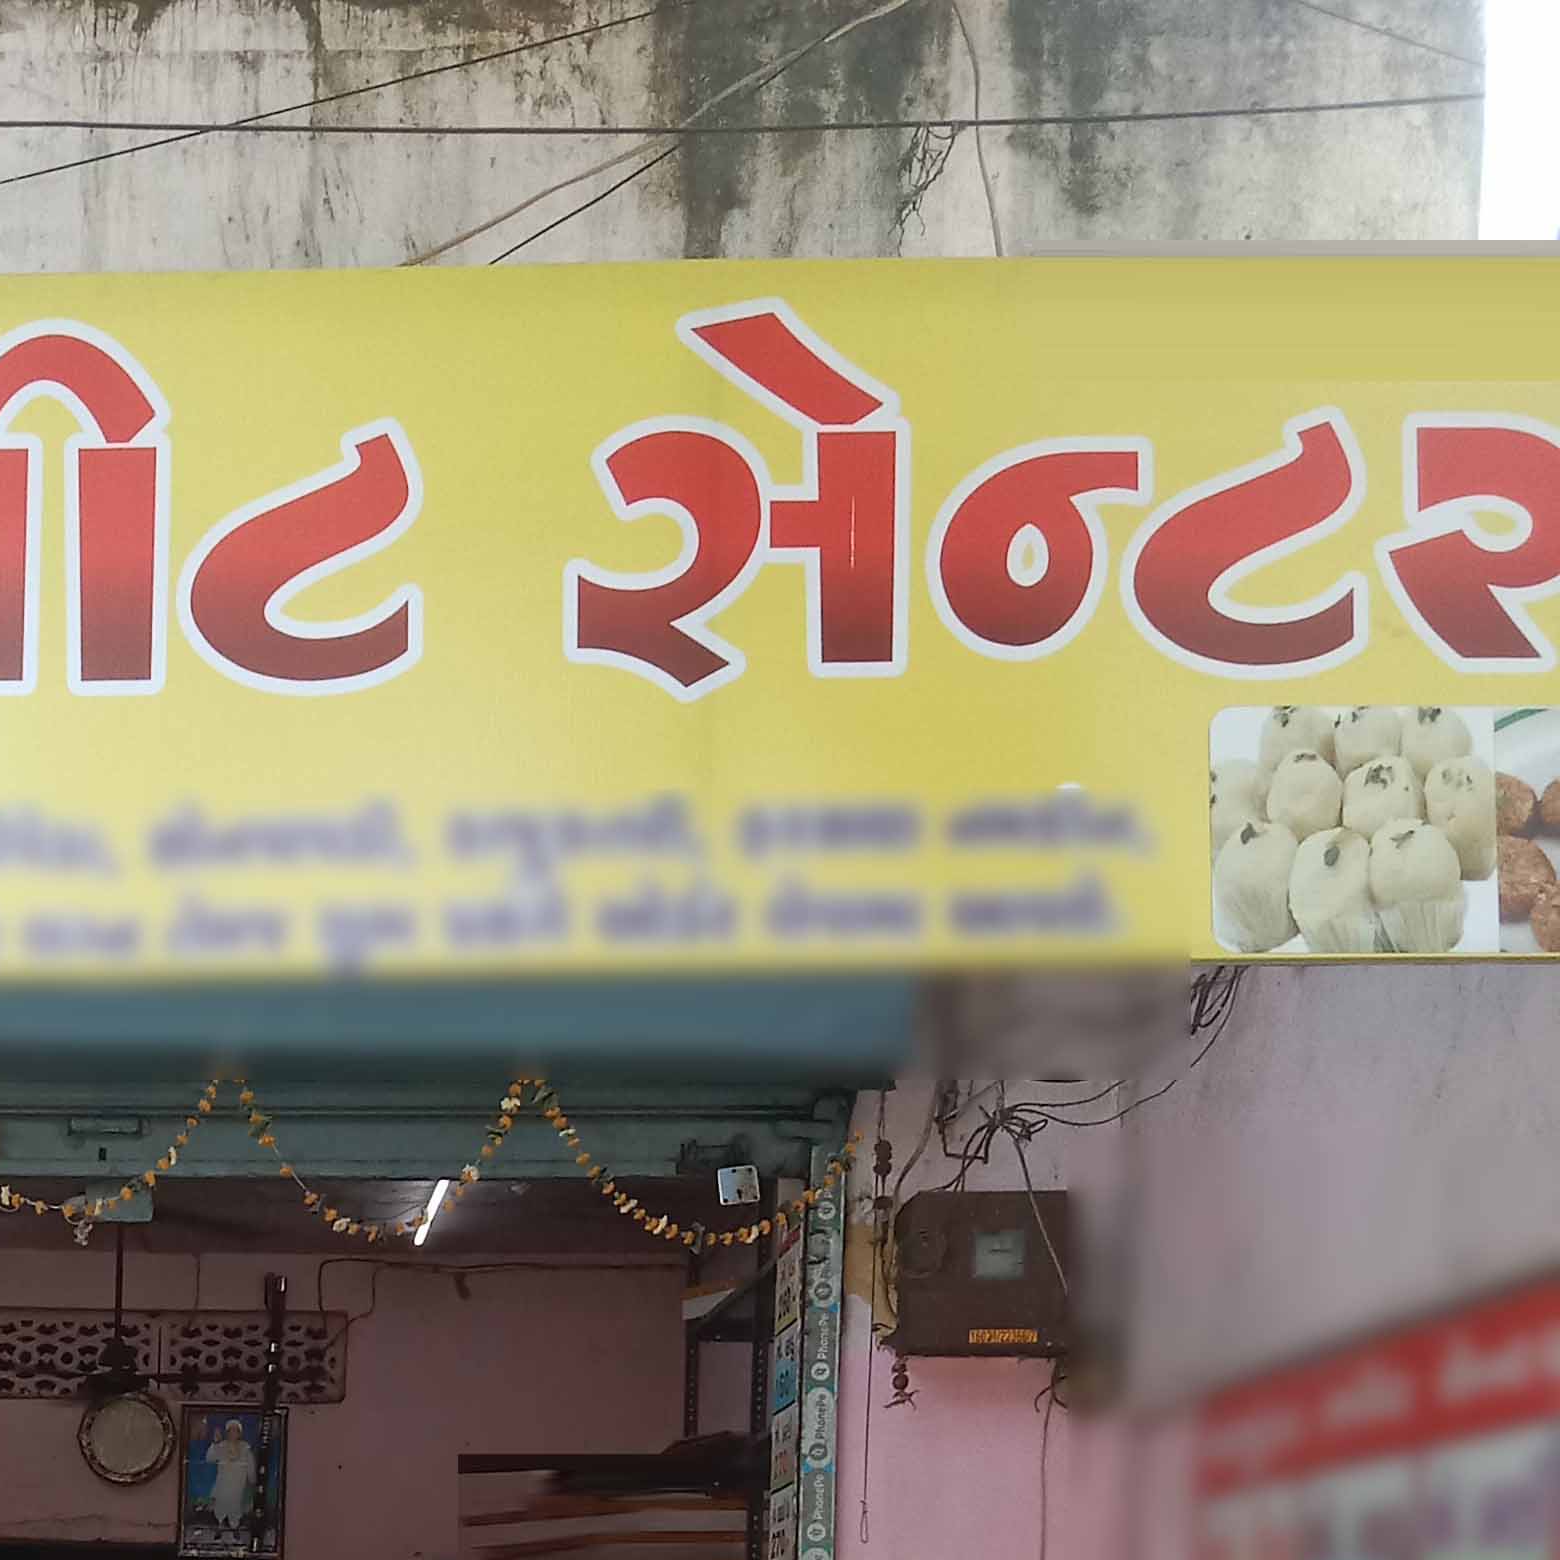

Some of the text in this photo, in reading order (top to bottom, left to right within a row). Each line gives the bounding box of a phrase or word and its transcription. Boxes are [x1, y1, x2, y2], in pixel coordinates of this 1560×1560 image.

[572, 306, 1560, 691] સેન્ટર
[814, 1392, 828, 1441] PhonePe
[813, 1472, 827, 1520] PhonePe
